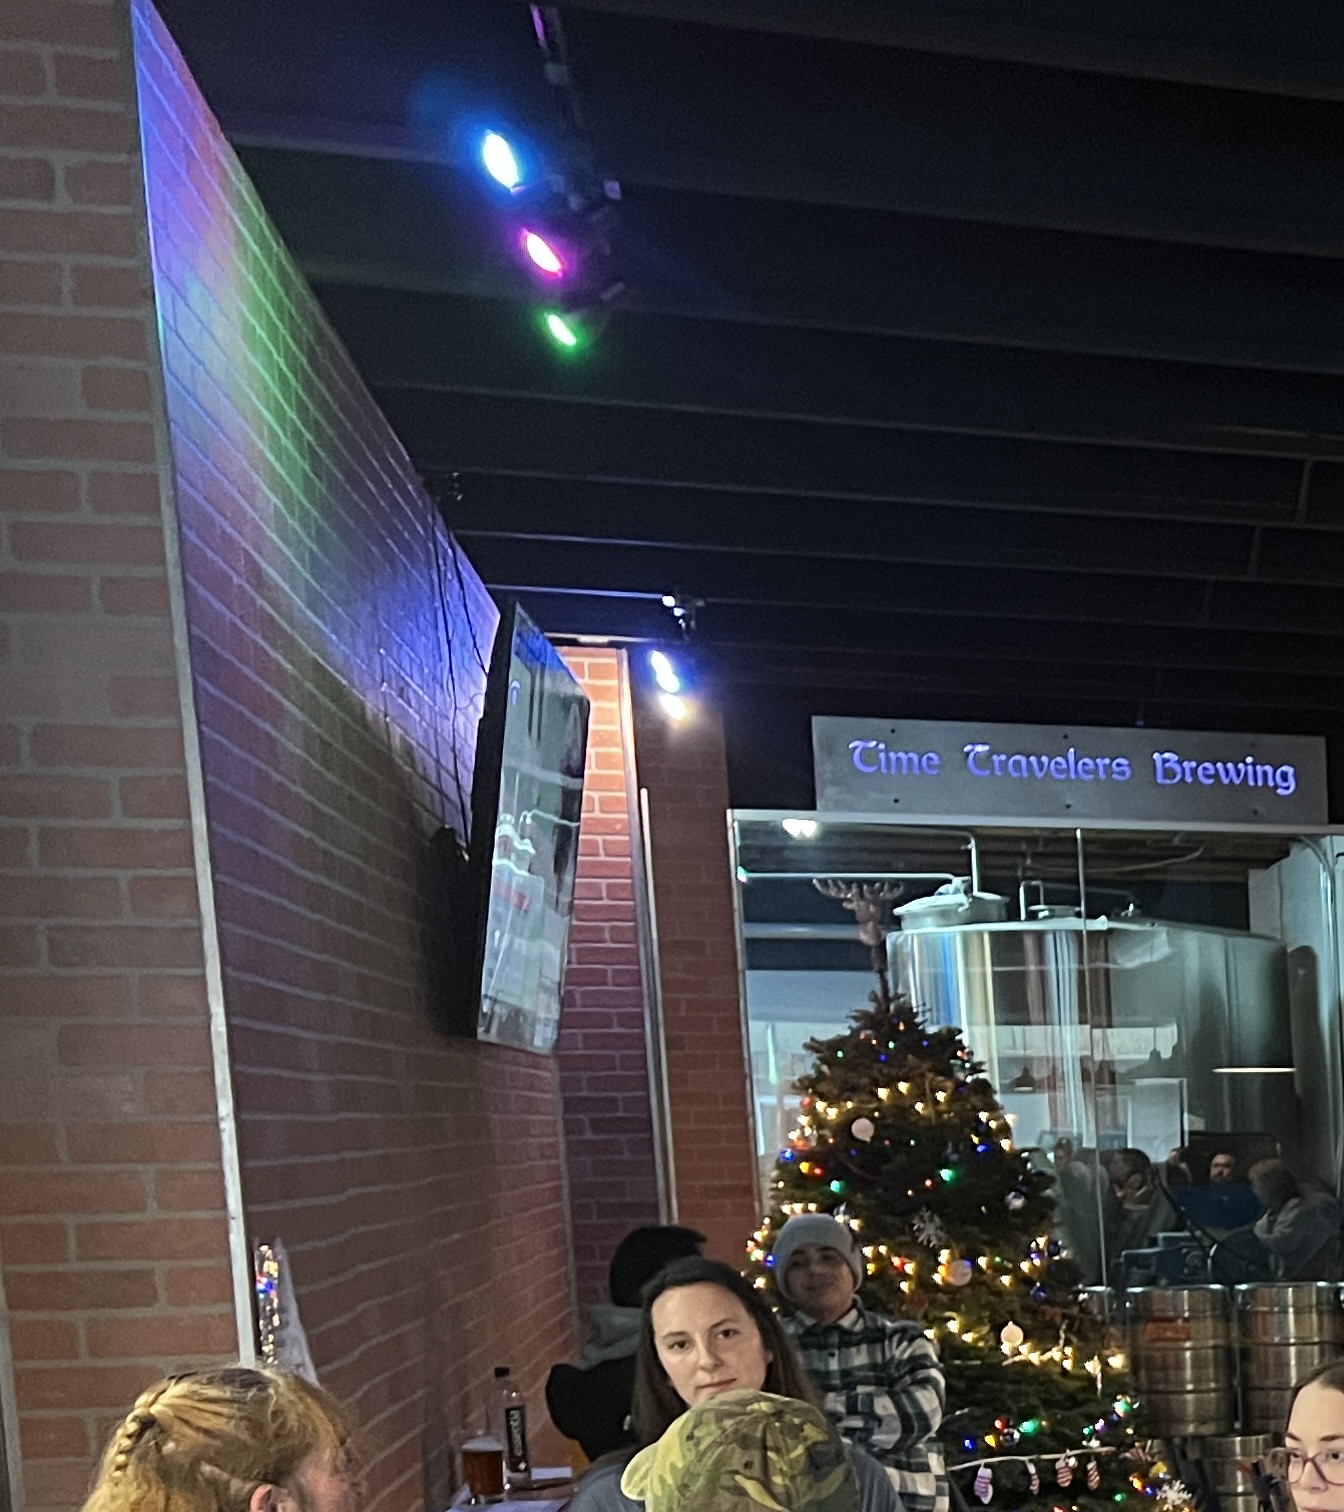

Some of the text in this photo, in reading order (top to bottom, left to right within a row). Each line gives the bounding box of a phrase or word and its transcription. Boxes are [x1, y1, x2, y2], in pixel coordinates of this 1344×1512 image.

[849, 740, 1297, 796] Time Travelers Brewing
